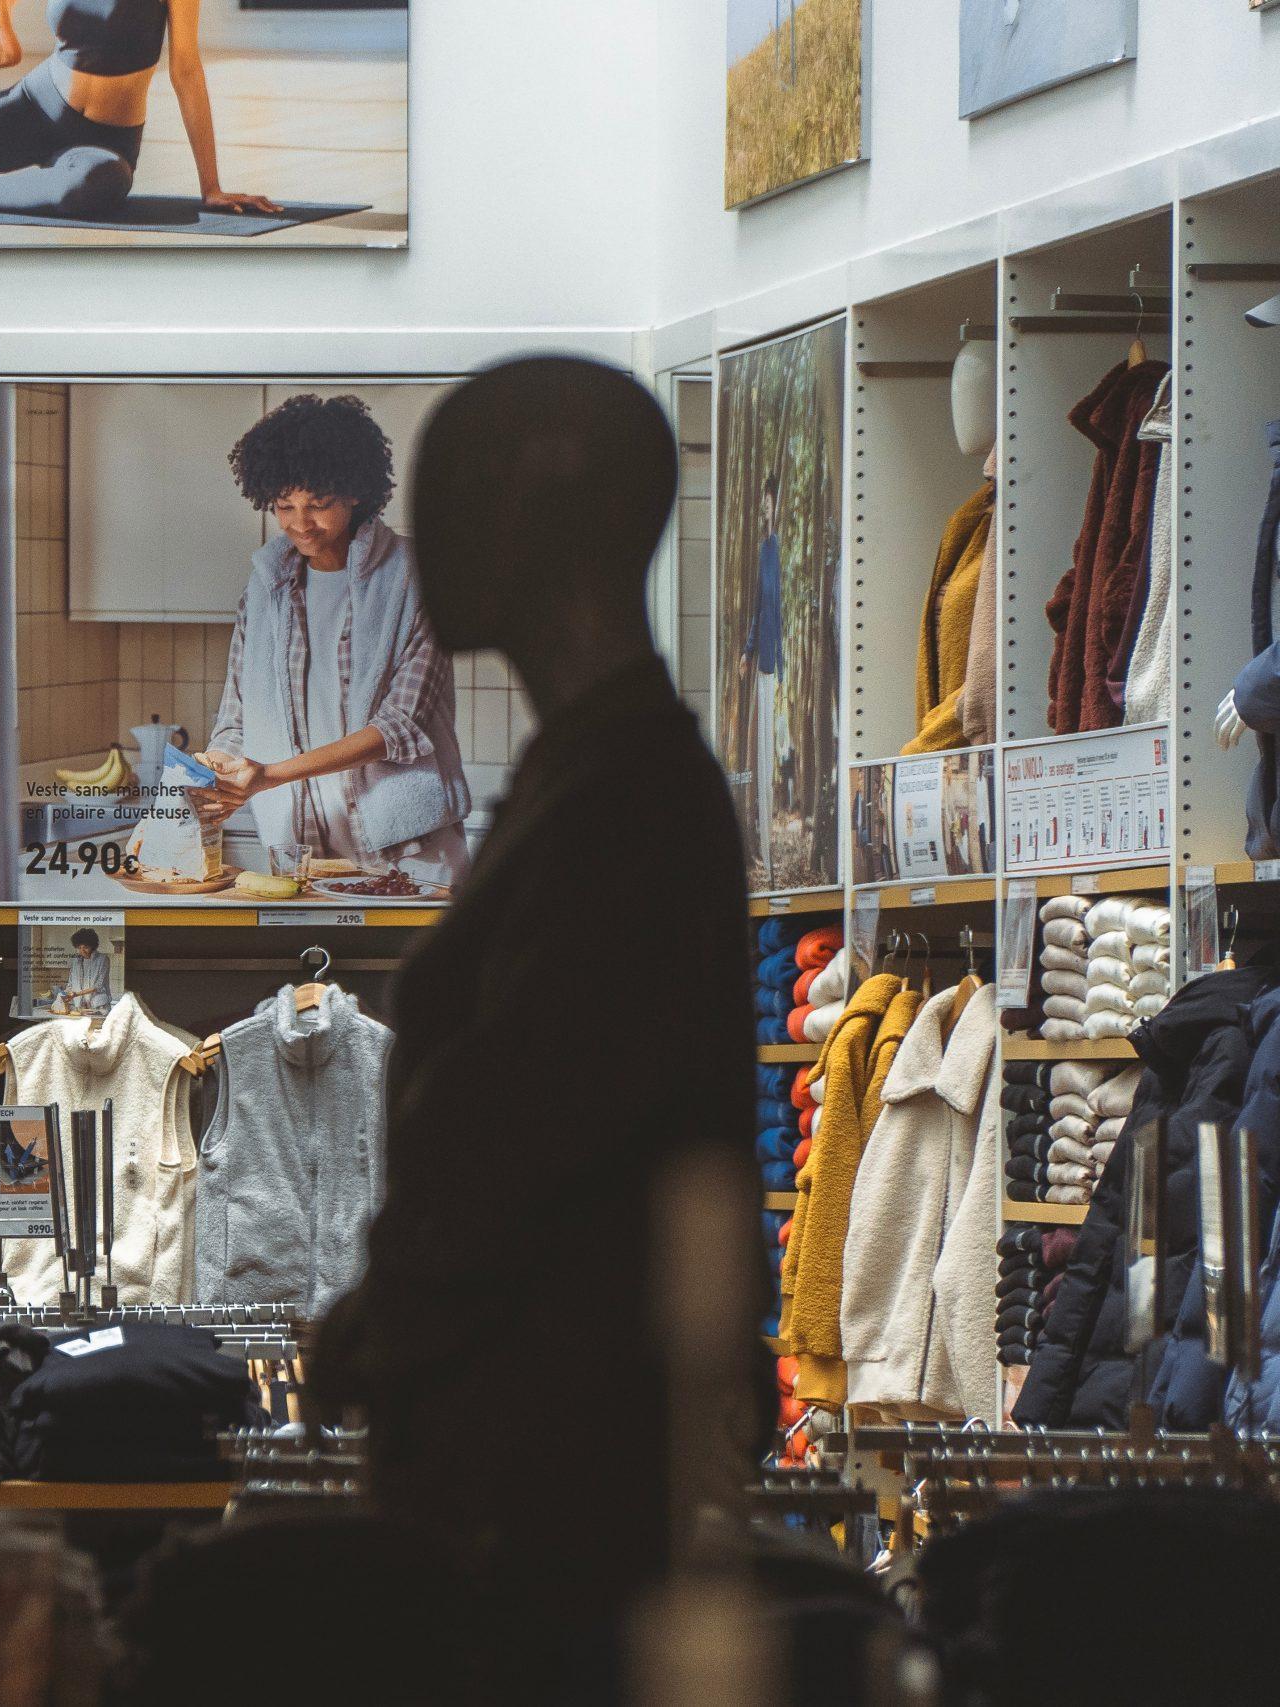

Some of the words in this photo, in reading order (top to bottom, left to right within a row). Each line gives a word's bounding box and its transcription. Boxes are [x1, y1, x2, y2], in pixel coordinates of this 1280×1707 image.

[26, 781, 68, 797] Veste
[75, 785, 109, 797] sans
[116, 781, 185, 797] manches
[26, 807, 44, 819] en
[52, 804, 106, 823] polaire
[113, 804, 191, 820] duveteuse
[26, 841, 139, 879] 24,90€
[92, 914, 113, 923] polaire
